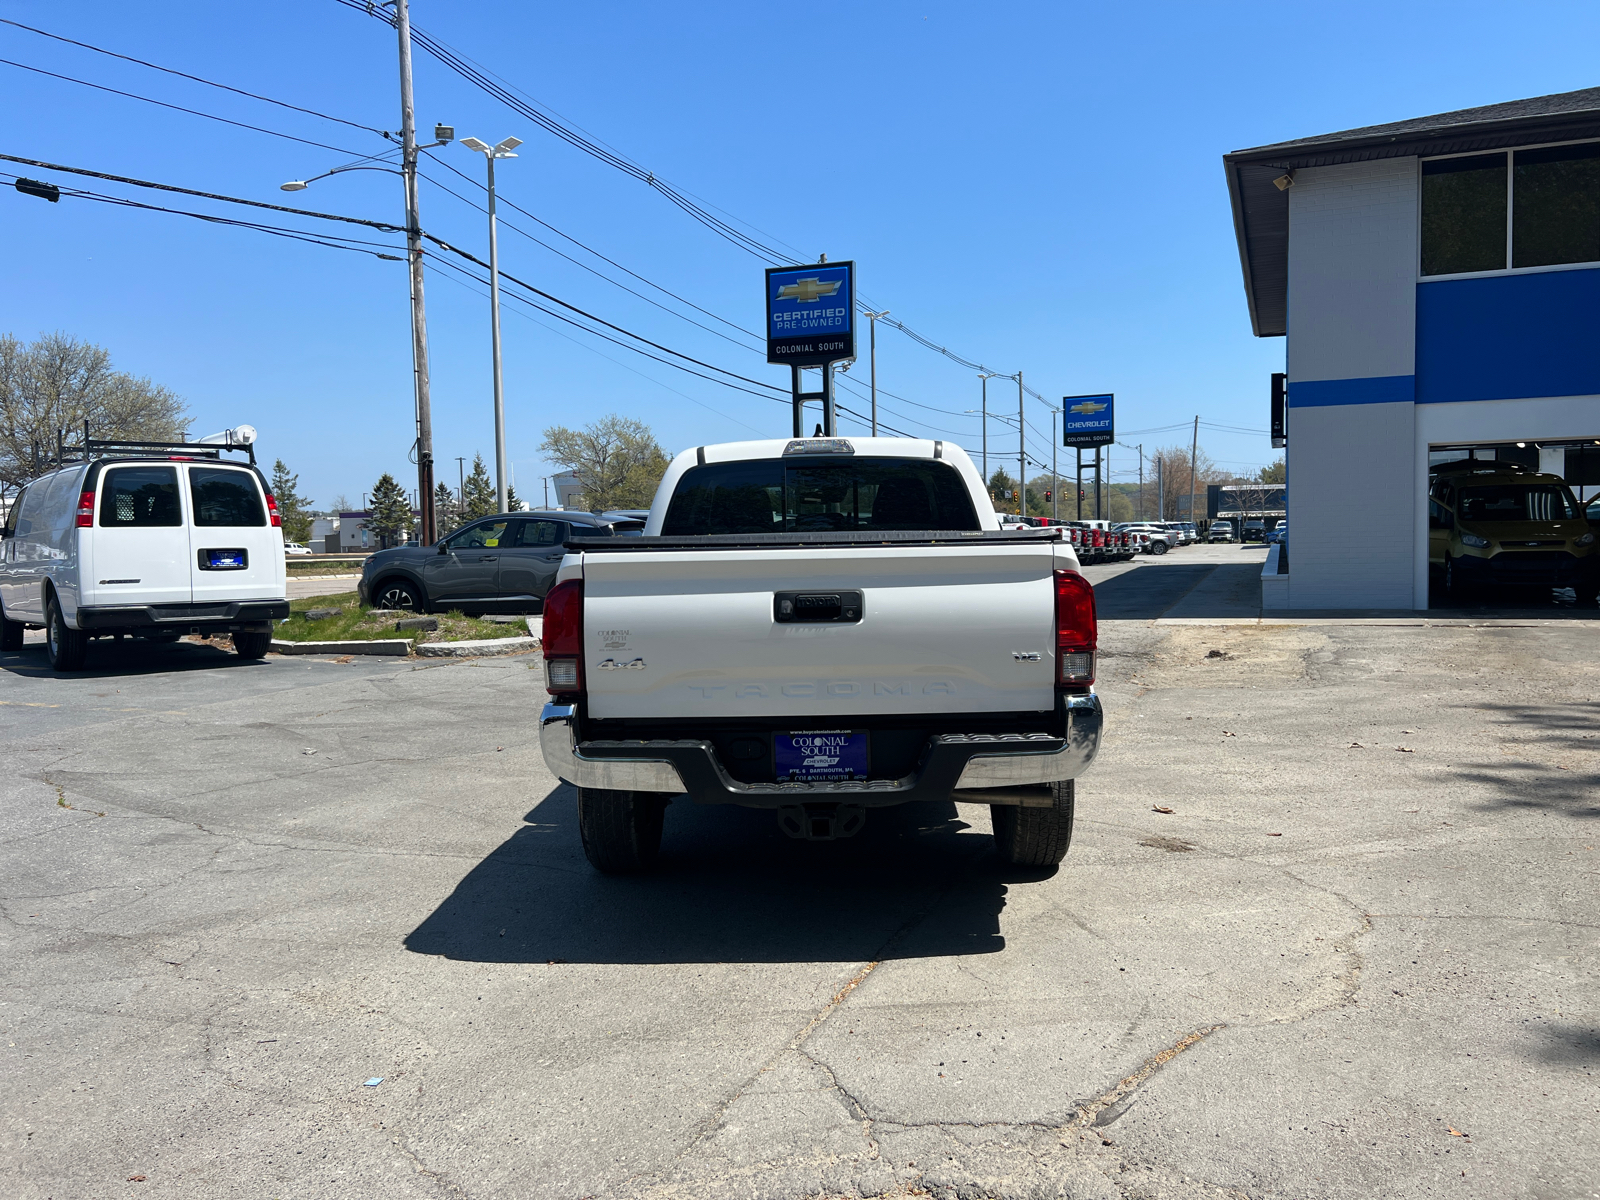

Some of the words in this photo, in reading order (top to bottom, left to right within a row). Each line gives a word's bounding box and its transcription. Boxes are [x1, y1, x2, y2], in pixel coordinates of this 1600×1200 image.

[773, 307, 846, 322] CERTIFIED
[777, 317, 842, 330] PRE-OWNED
[776, 344, 814, 354] COLONIAL
[818, 342, 844, 351] SOUTH
[1067, 420, 1110, 429] CHEVROLET
[799, 597, 838, 606] TOYOTA
[688, 680, 957, 699] TACOMA
[792, 736, 849, 747] COLONIAL
[801, 746, 840, 756] SOUTH
